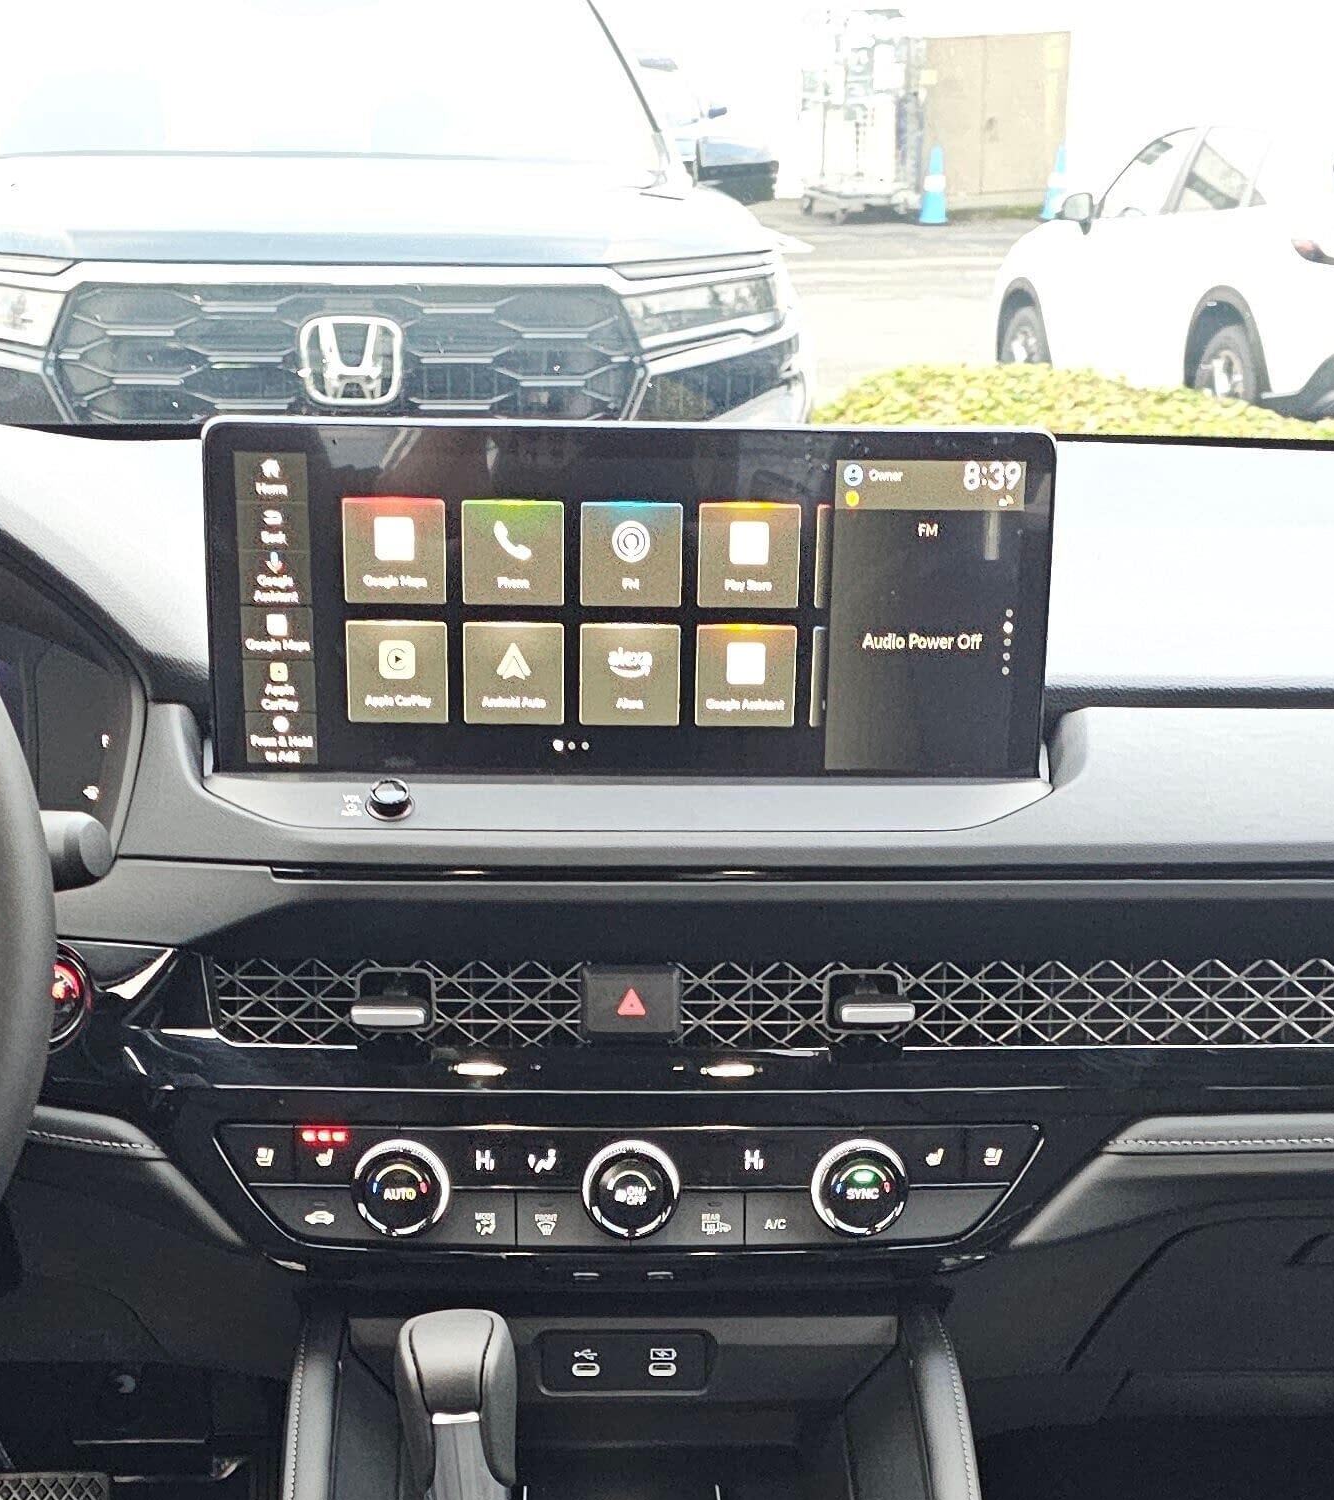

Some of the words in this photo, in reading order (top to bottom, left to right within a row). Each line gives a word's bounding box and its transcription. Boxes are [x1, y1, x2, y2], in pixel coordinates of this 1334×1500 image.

[868, 469, 903, 482] Owner
[963, 460, 1021, 491] 8:39
[918, 523, 938, 537] FM
[862, 633, 905, 649] Audio
[908, 634, 954, 649] Power
[957, 633, 983, 649] Off
[383, 1187, 417, 1201] AUTO
[846, 1187, 880, 1200] SYNC
[534, 1213, 558, 1222] FRONT
[764, 1217, 787, 1231] A/C
